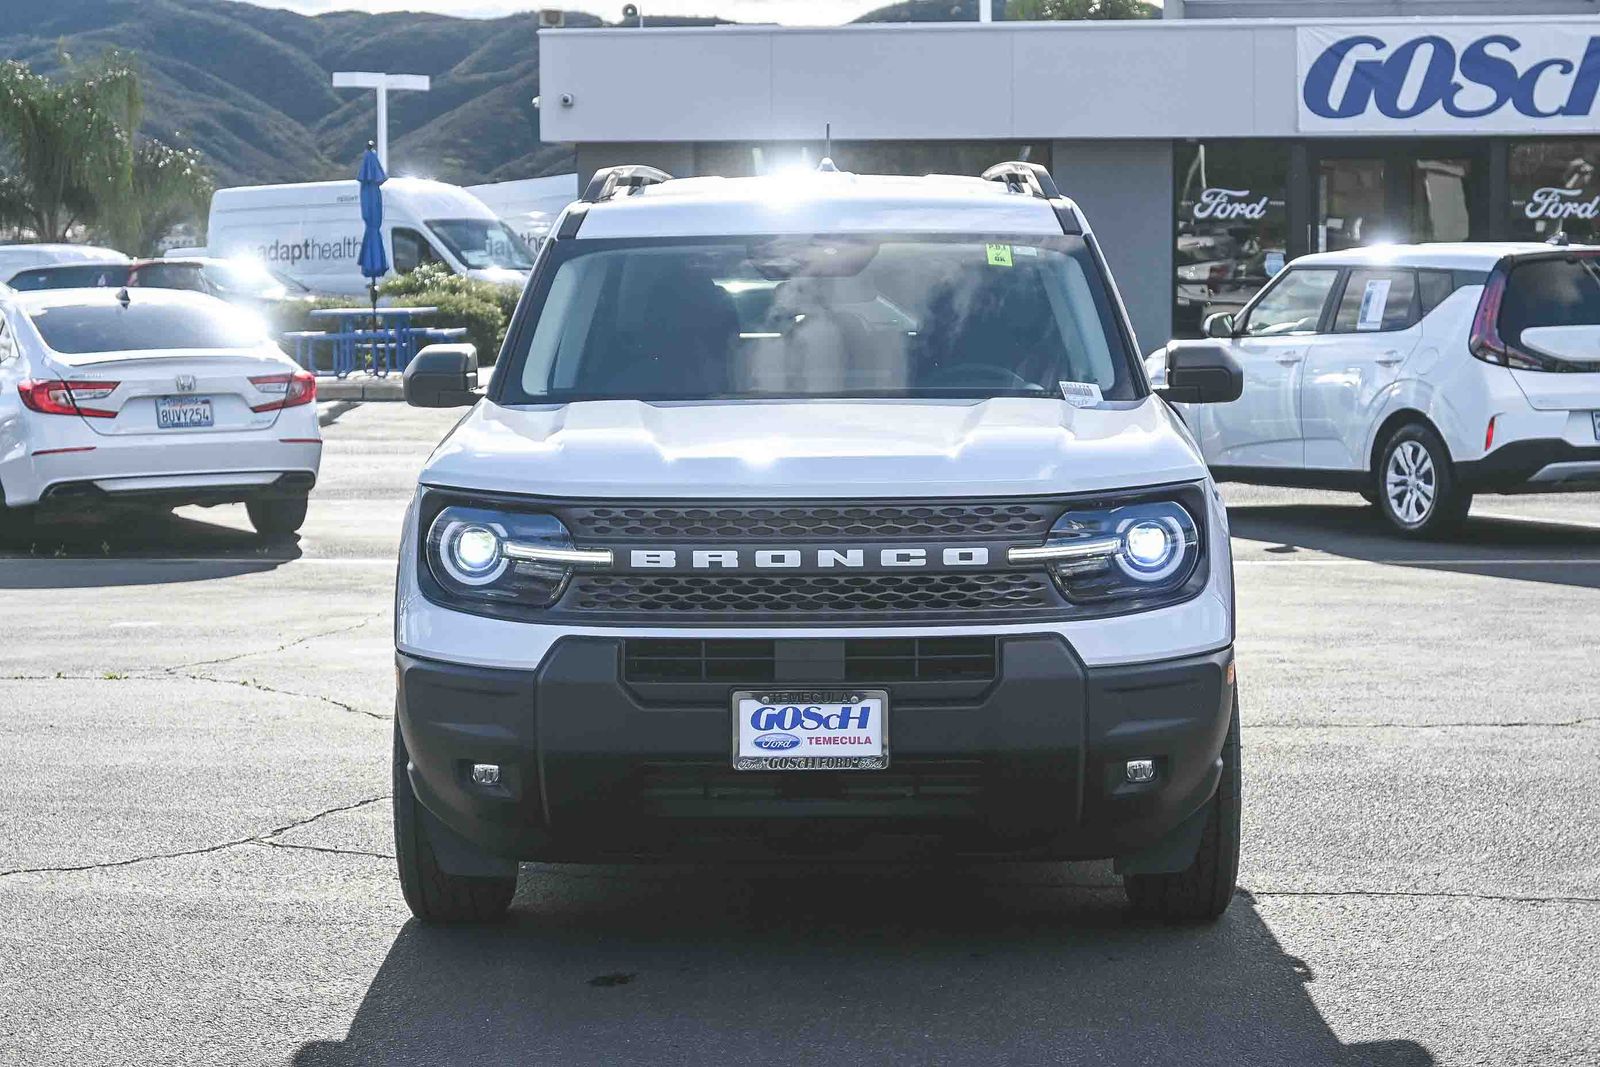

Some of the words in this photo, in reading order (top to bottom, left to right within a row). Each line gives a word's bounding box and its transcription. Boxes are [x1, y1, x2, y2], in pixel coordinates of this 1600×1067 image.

[1194, 188, 1268, 219] Ford
[1525, 187, 1600, 219] Ford
[161, 407, 209, 424] 8UVY254
[630, 547, 989, 568] BRONCO
[769, 692, 849, 704] TEMECULA
[761, 736, 792, 749] Ford
[807, 736, 872, 746] TEMECULA
